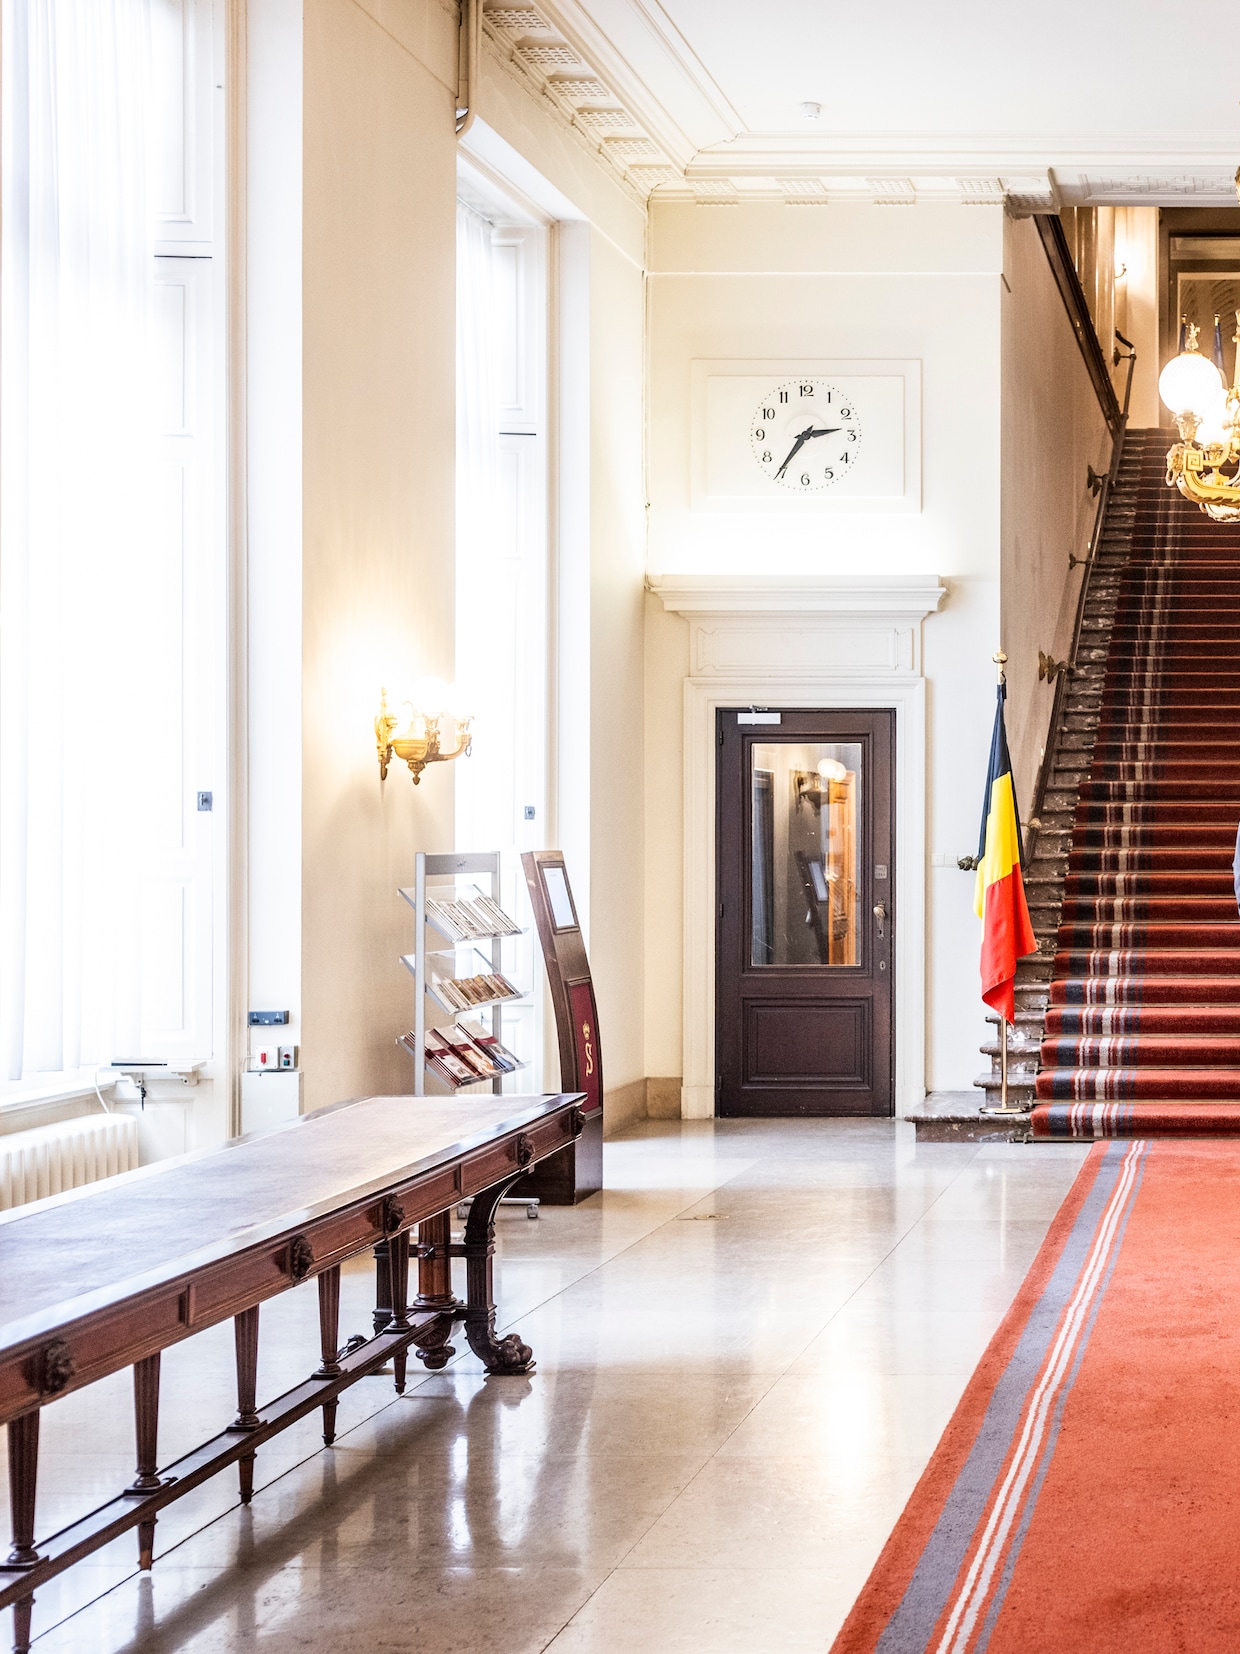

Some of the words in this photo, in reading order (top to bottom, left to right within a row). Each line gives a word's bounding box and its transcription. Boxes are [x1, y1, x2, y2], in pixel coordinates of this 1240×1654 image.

[779, 391, 788, 403] 11
[799, 385, 814, 397] 12
[762, 408, 776, 420] 10
[840, 408, 852, 420] 2
[755, 429, 765, 441] 9
[847, 429, 857, 442] 3
[762, 451, 772, 463] 8
[839, 452, 849, 464] 4
[824, 467, 834, 479] 5
[800, 473, 810, 486] 6
